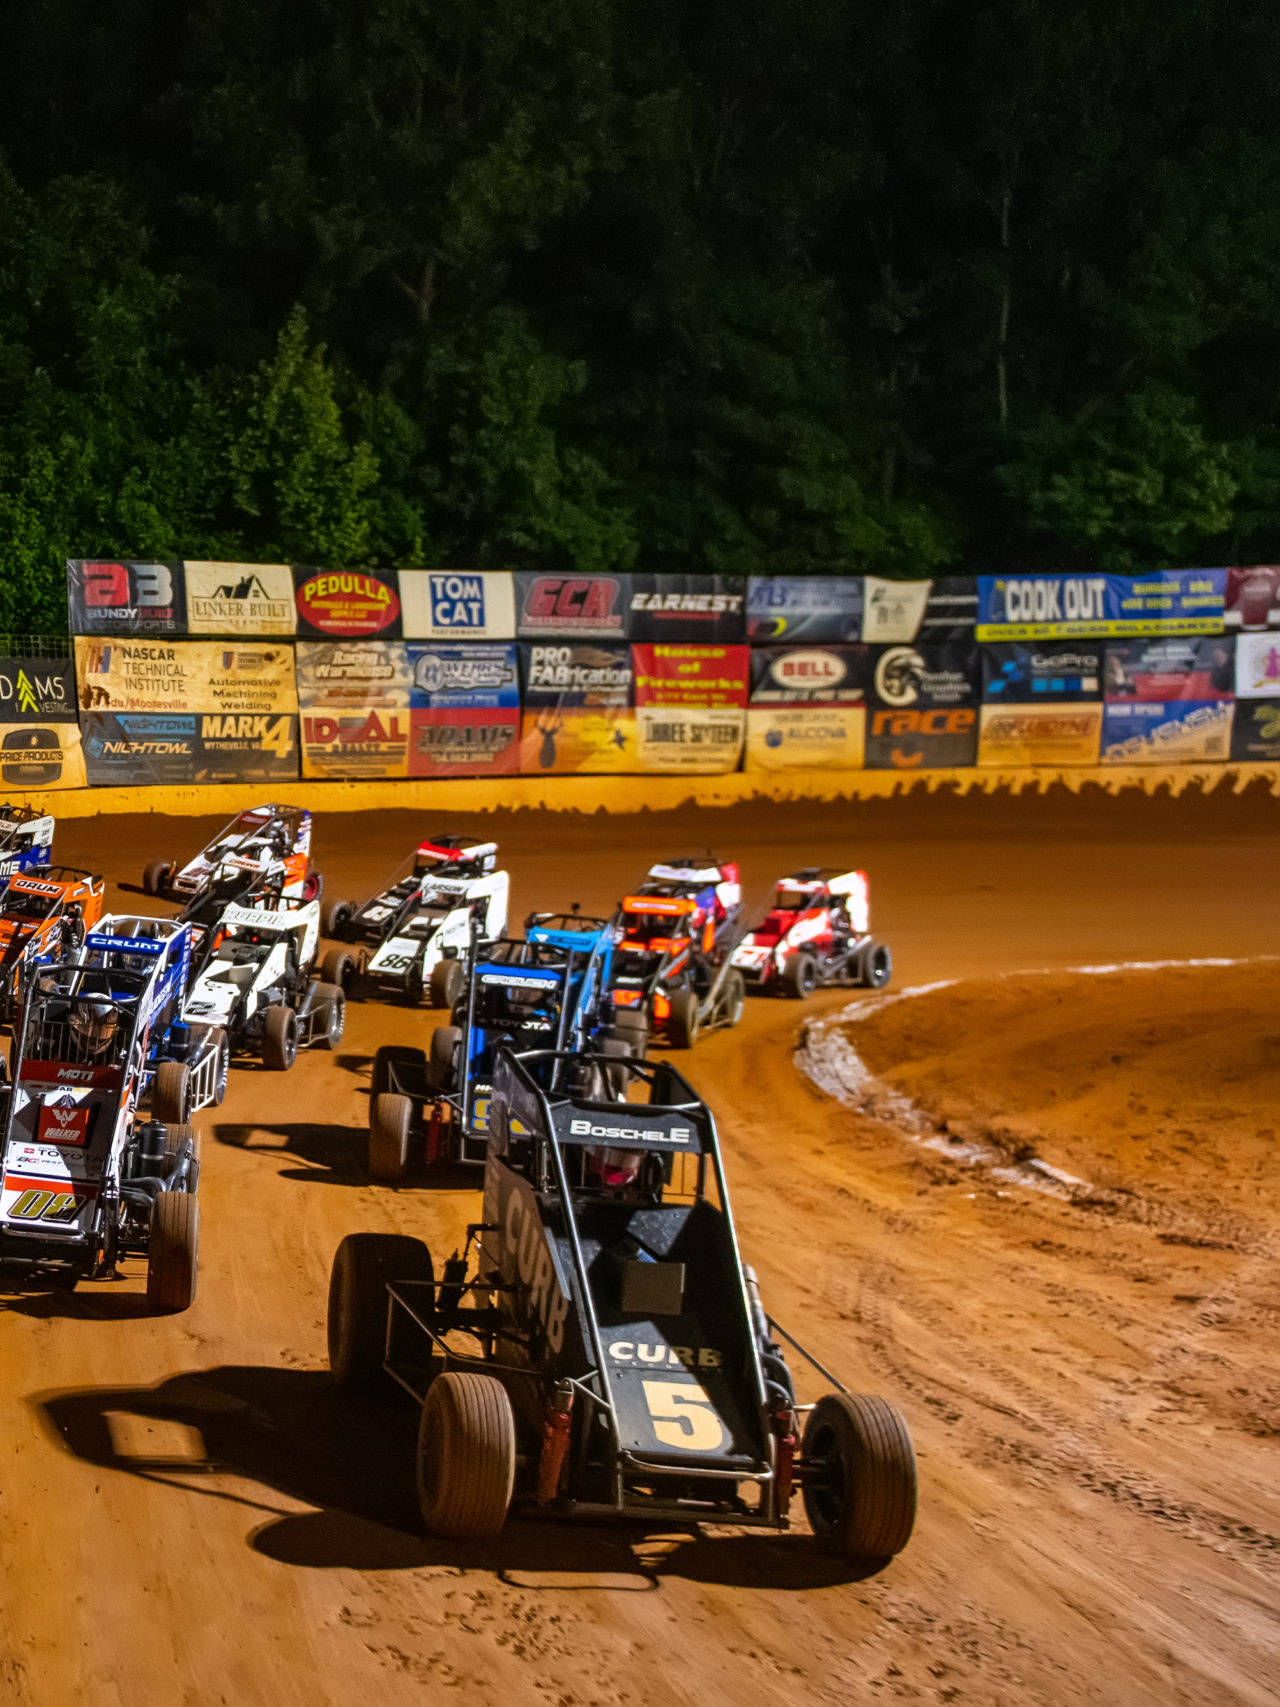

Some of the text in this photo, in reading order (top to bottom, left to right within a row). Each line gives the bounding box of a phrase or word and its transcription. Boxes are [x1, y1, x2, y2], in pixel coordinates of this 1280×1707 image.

[304, 575, 391, 605] PEDULLA
[431, 576, 482, 599] TOM
[630, 593, 743, 611] EARNEST
[1005, 578, 1106, 622] COOK OUT
[86, 608, 138, 619] BUNDY
[435, 602, 482, 625] CAT
[122, 648, 175, 661] NASCAR
[530, 646, 572, 666] PRO
[124, 662, 188, 677] TECHNICAL
[677, 661, 701, 674] of
[782, 662, 835, 677] BELL
[125, 678, 185, 692] INSTITUTE
[208, 677, 281, 687] Automotive
[636, 675, 744, 689] Fireworks
[213, 690, 277, 700] Machining
[221, 701, 271, 711] Welding
[202, 716, 268, 738] MARK
[261, 716, 293, 759] 4
[102, 741, 192, 754] NIGHTOWL
[0, 751, 23, 762] PRICE
[423, 882, 465, 893] LARSON
[90, 936, 160, 950] CRUM
[377, 953, 413, 969] 86
[56, 1067, 95, 1081] MOTI
[43, 1127, 81, 1141] WALKER
[38, 1149, 104, 1162] TOYOTA
[8, 1189, 87, 1223] 08
[505, 1187, 570, 1354] CURB
[608, 1341, 723, 1367] CURB
[642, 1380, 722, 1451] 5
